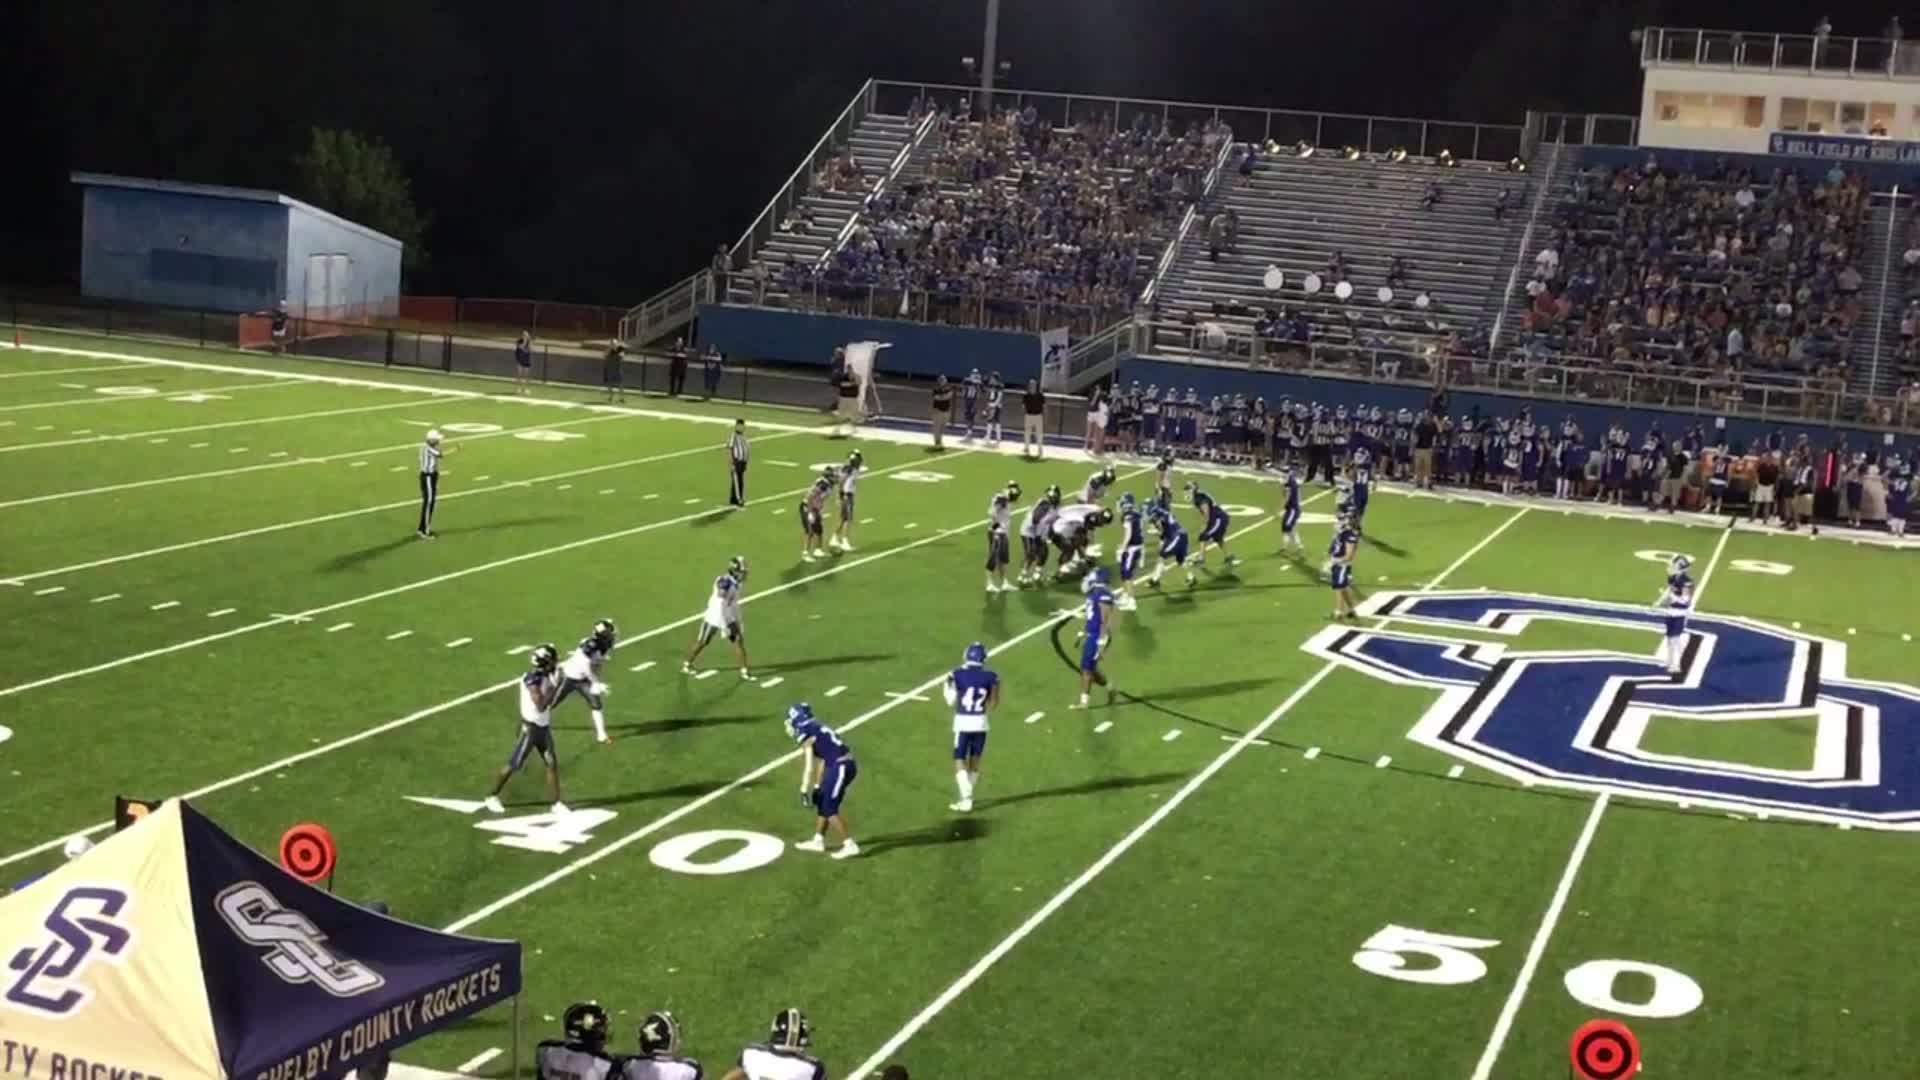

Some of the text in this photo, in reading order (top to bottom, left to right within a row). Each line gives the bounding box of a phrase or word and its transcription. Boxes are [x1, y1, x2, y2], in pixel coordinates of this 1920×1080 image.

[961, 686, 988, 713] 42
[256, 962, 502, 1080] HELBY COUNTY ROCKETS
[50, 1052, 164, 1080] ROC
